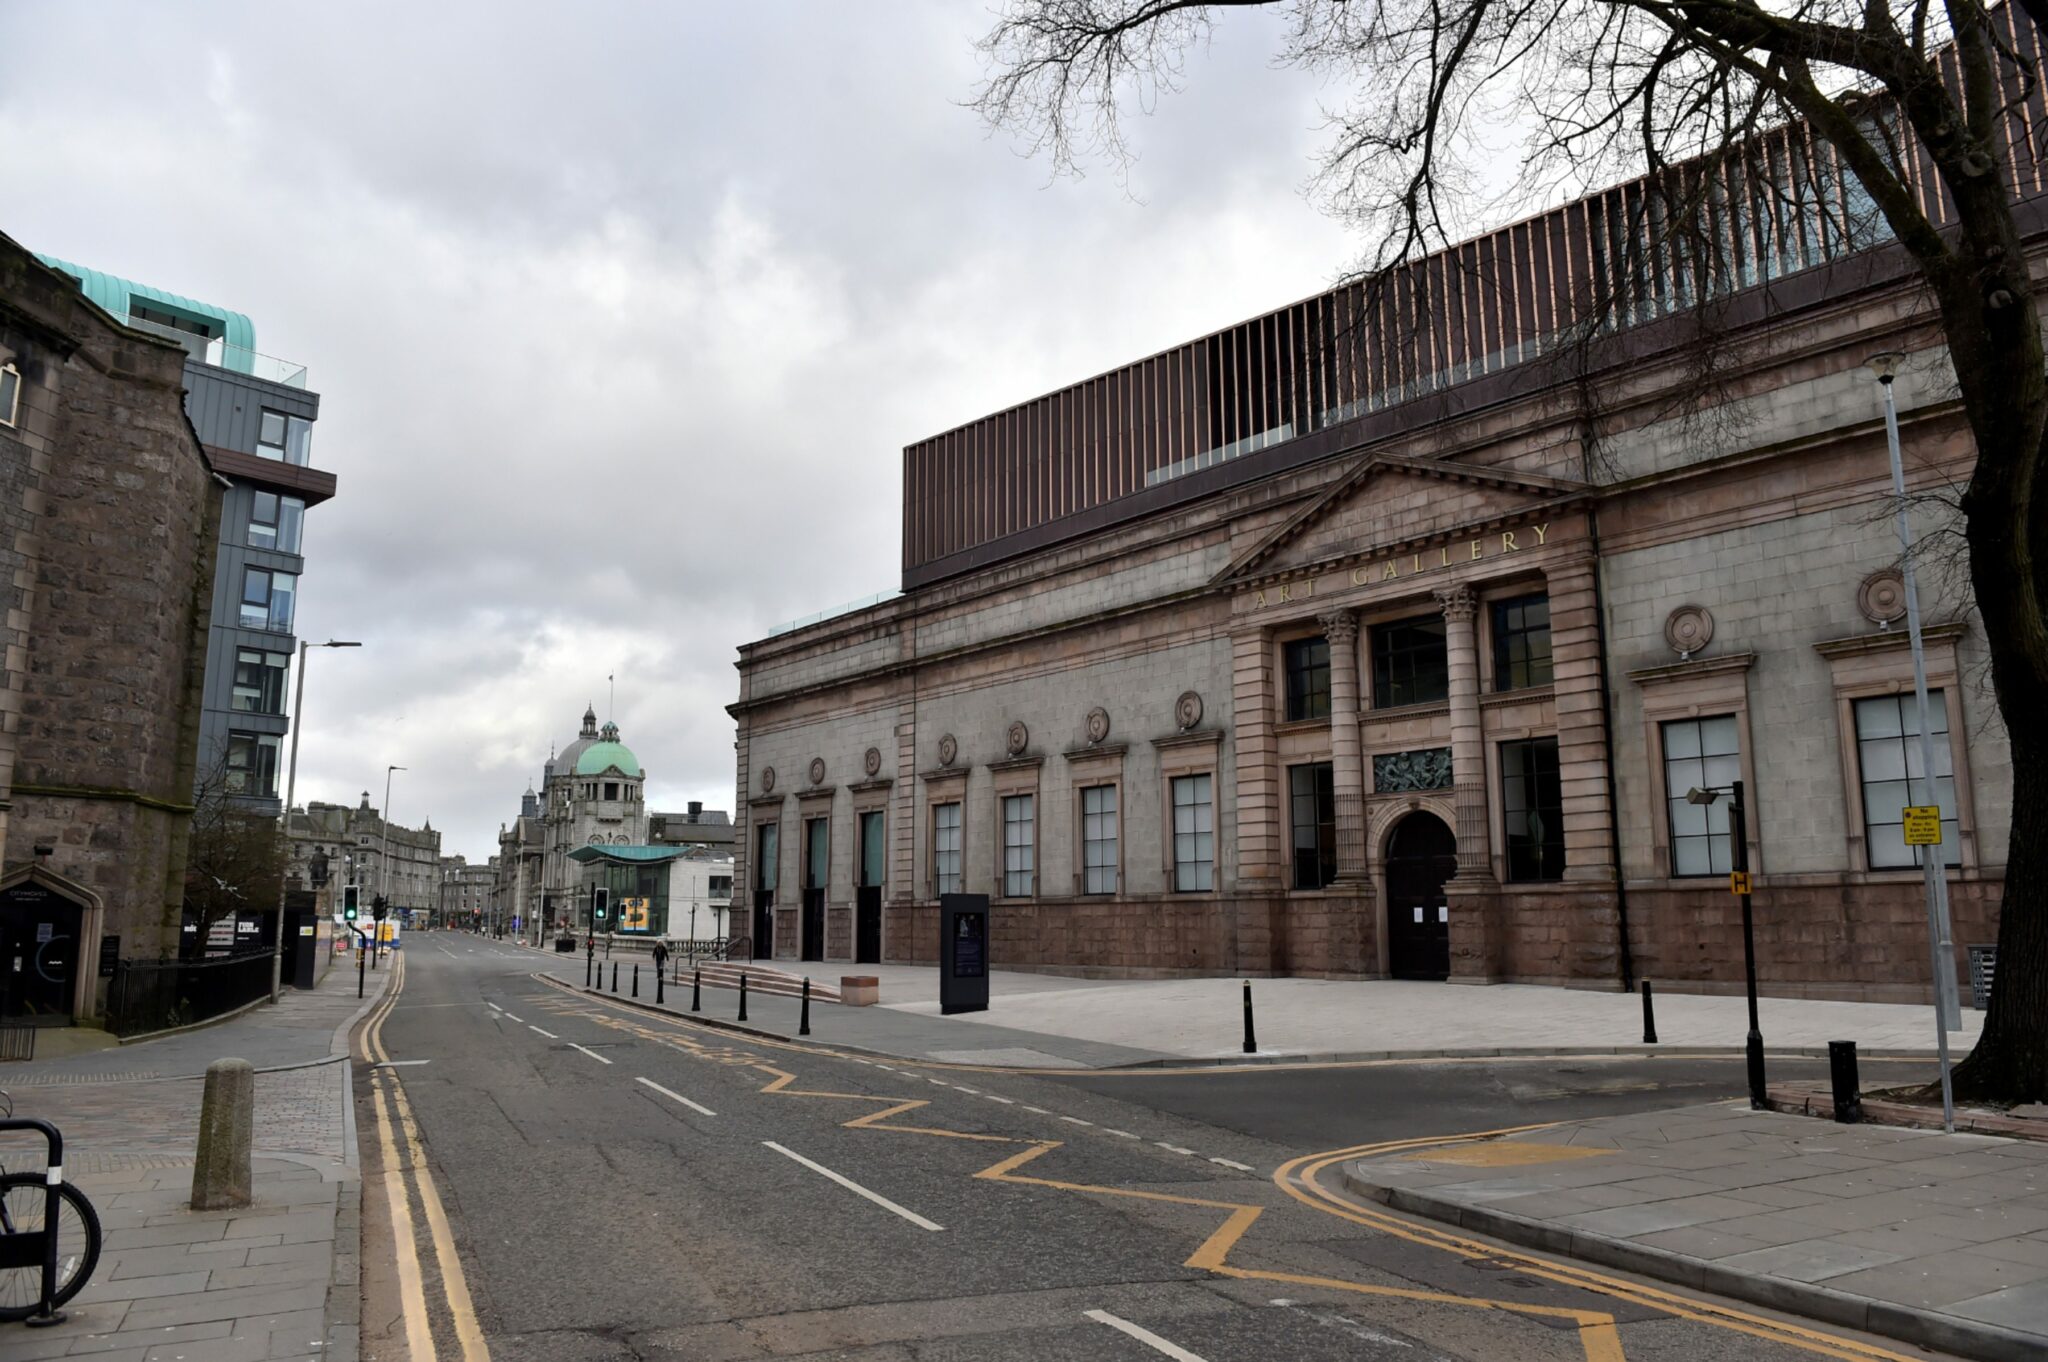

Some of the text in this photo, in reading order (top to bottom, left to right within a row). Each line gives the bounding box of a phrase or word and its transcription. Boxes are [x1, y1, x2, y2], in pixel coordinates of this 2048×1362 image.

[1254, 523, 1549, 609] ART GALLERY
[1734, 874, 1748, 892] H
